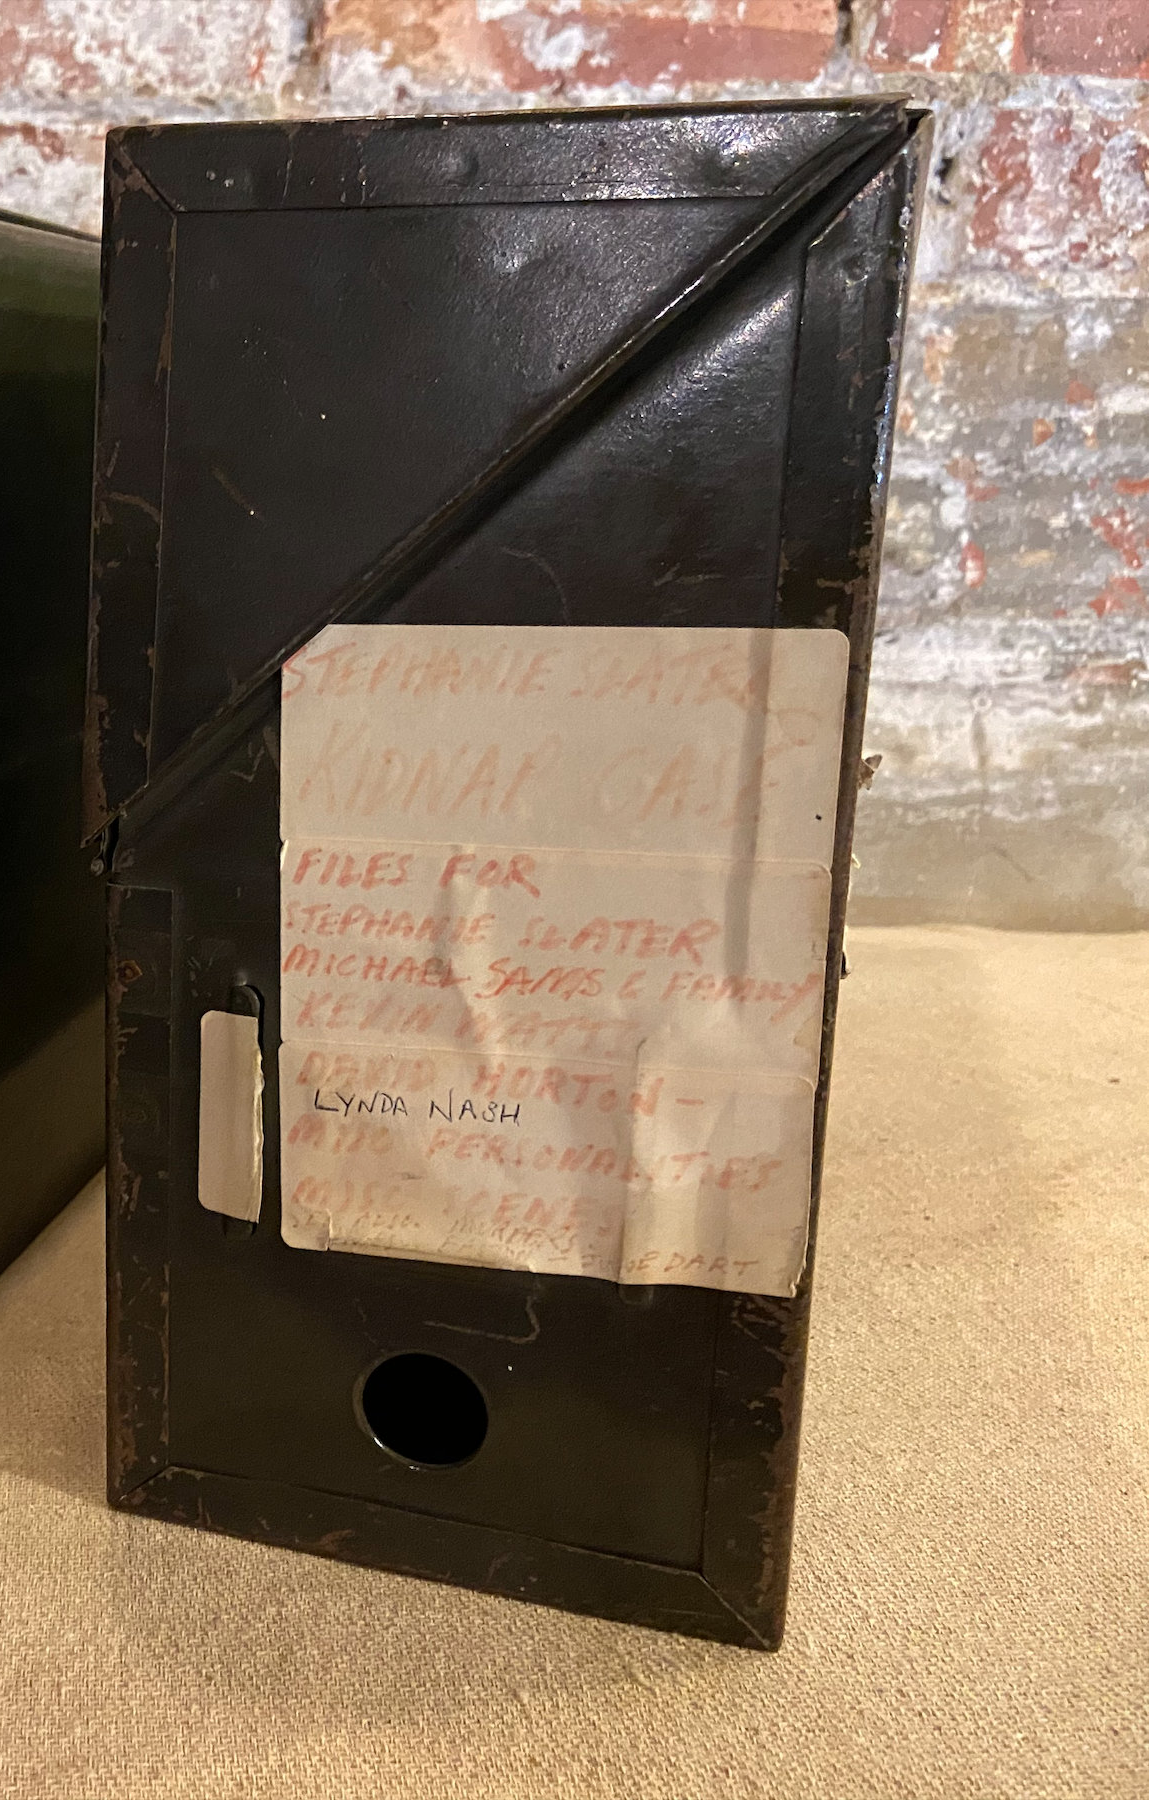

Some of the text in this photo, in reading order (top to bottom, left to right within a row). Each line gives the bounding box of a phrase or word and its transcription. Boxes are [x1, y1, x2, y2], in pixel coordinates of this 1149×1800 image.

[293, 848, 541, 897] FILES FOR
[285, 903, 721, 965] STEPHANIE SLATER
[283, 943, 471, 988] MICHAEL
[475, 957, 606, 1001] SAMS
[296, 990, 445, 1035] KEVIN
[295, 1050, 435, 1093] DAVID
[470, 1061, 665, 1117] HORTON
[314, 1088, 520, 1127] LYNDA NASH
[664, 1253, 760, 1277] DART
